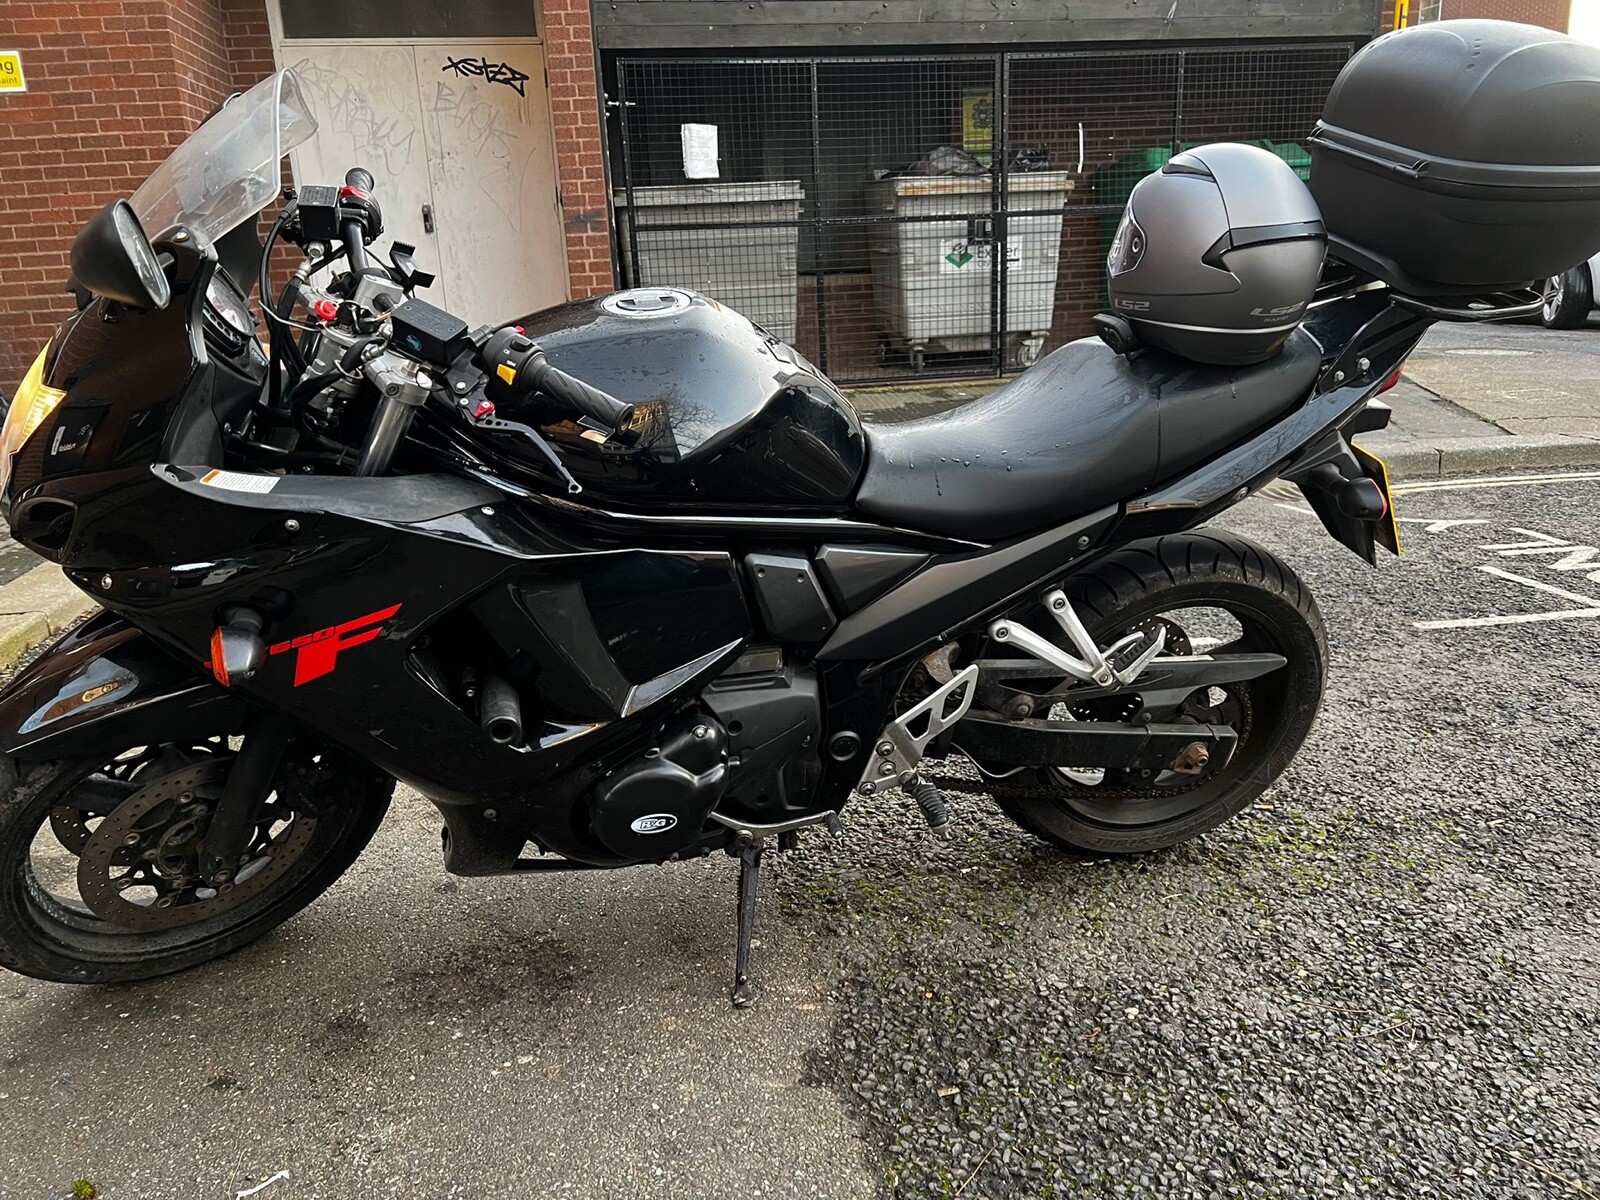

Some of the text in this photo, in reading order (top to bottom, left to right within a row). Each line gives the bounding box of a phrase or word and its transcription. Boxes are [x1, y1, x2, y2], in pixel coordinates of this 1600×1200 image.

[977, 246, 1019, 258] Exer
[1114, 298, 1150, 312] LS2
[1250, 300, 1306, 317] LS2
[640, 818, 667, 829] R&G
